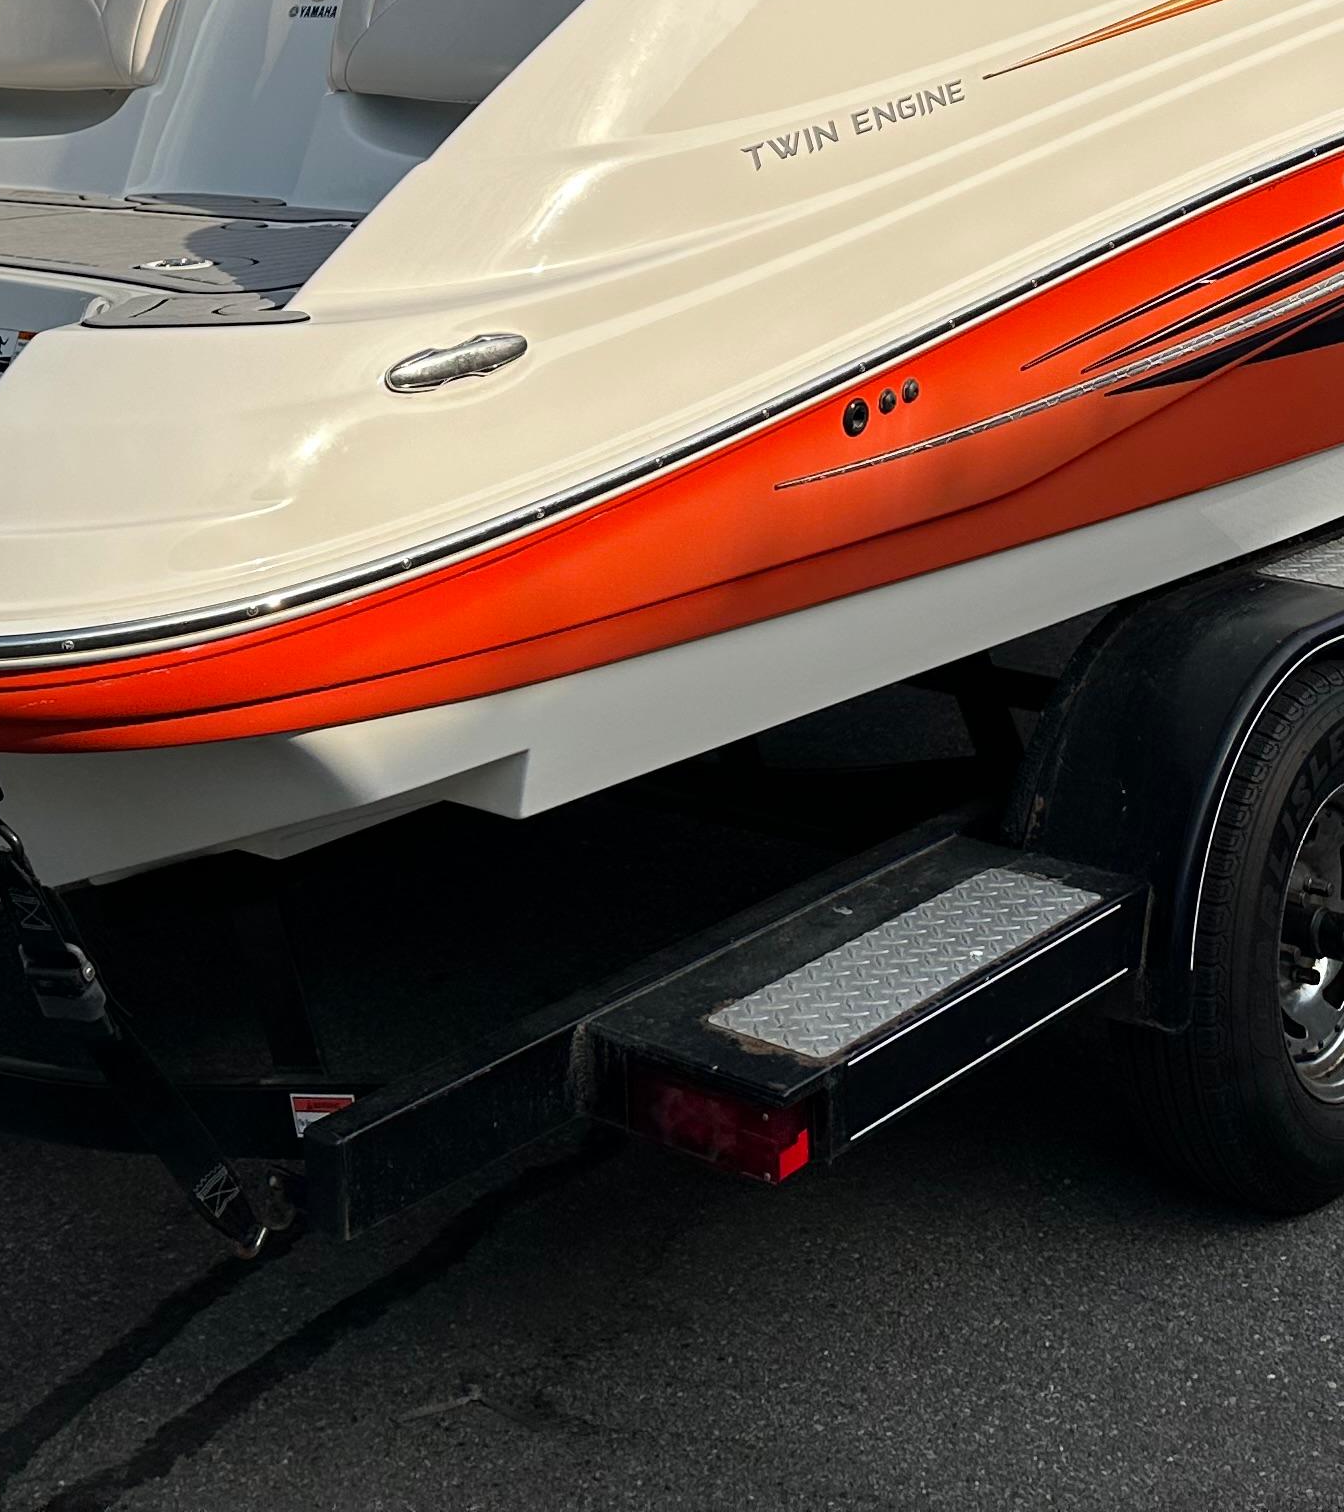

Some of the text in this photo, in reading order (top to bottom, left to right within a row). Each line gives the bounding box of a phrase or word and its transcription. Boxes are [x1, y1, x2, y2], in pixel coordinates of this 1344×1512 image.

[299, 5, 338, 19] YAMAHA
[740, 78, 966, 172] TWIN ENGINE
